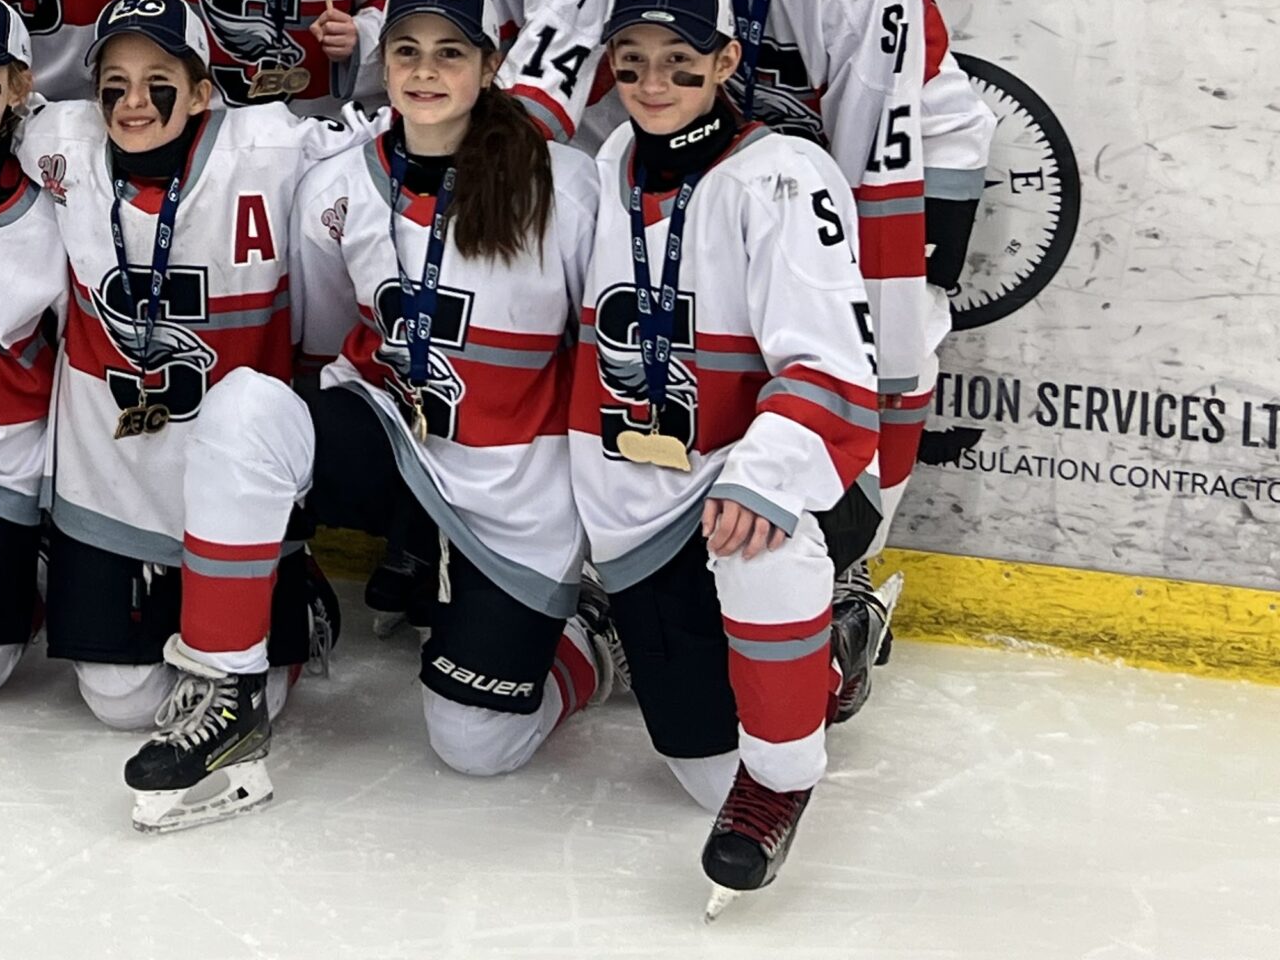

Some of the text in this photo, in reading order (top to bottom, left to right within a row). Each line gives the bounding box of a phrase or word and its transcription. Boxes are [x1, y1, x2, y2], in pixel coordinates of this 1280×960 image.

[521, 26, 590, 96] 14
[669, 117, 721, 150] CCM
[1009, 166, 1044, 194] E
[233, 194, 276, 264] A
[1036, 381, 1225, 444] SERVICES
[1110, 463, 1280, 503] CONTRACTO
